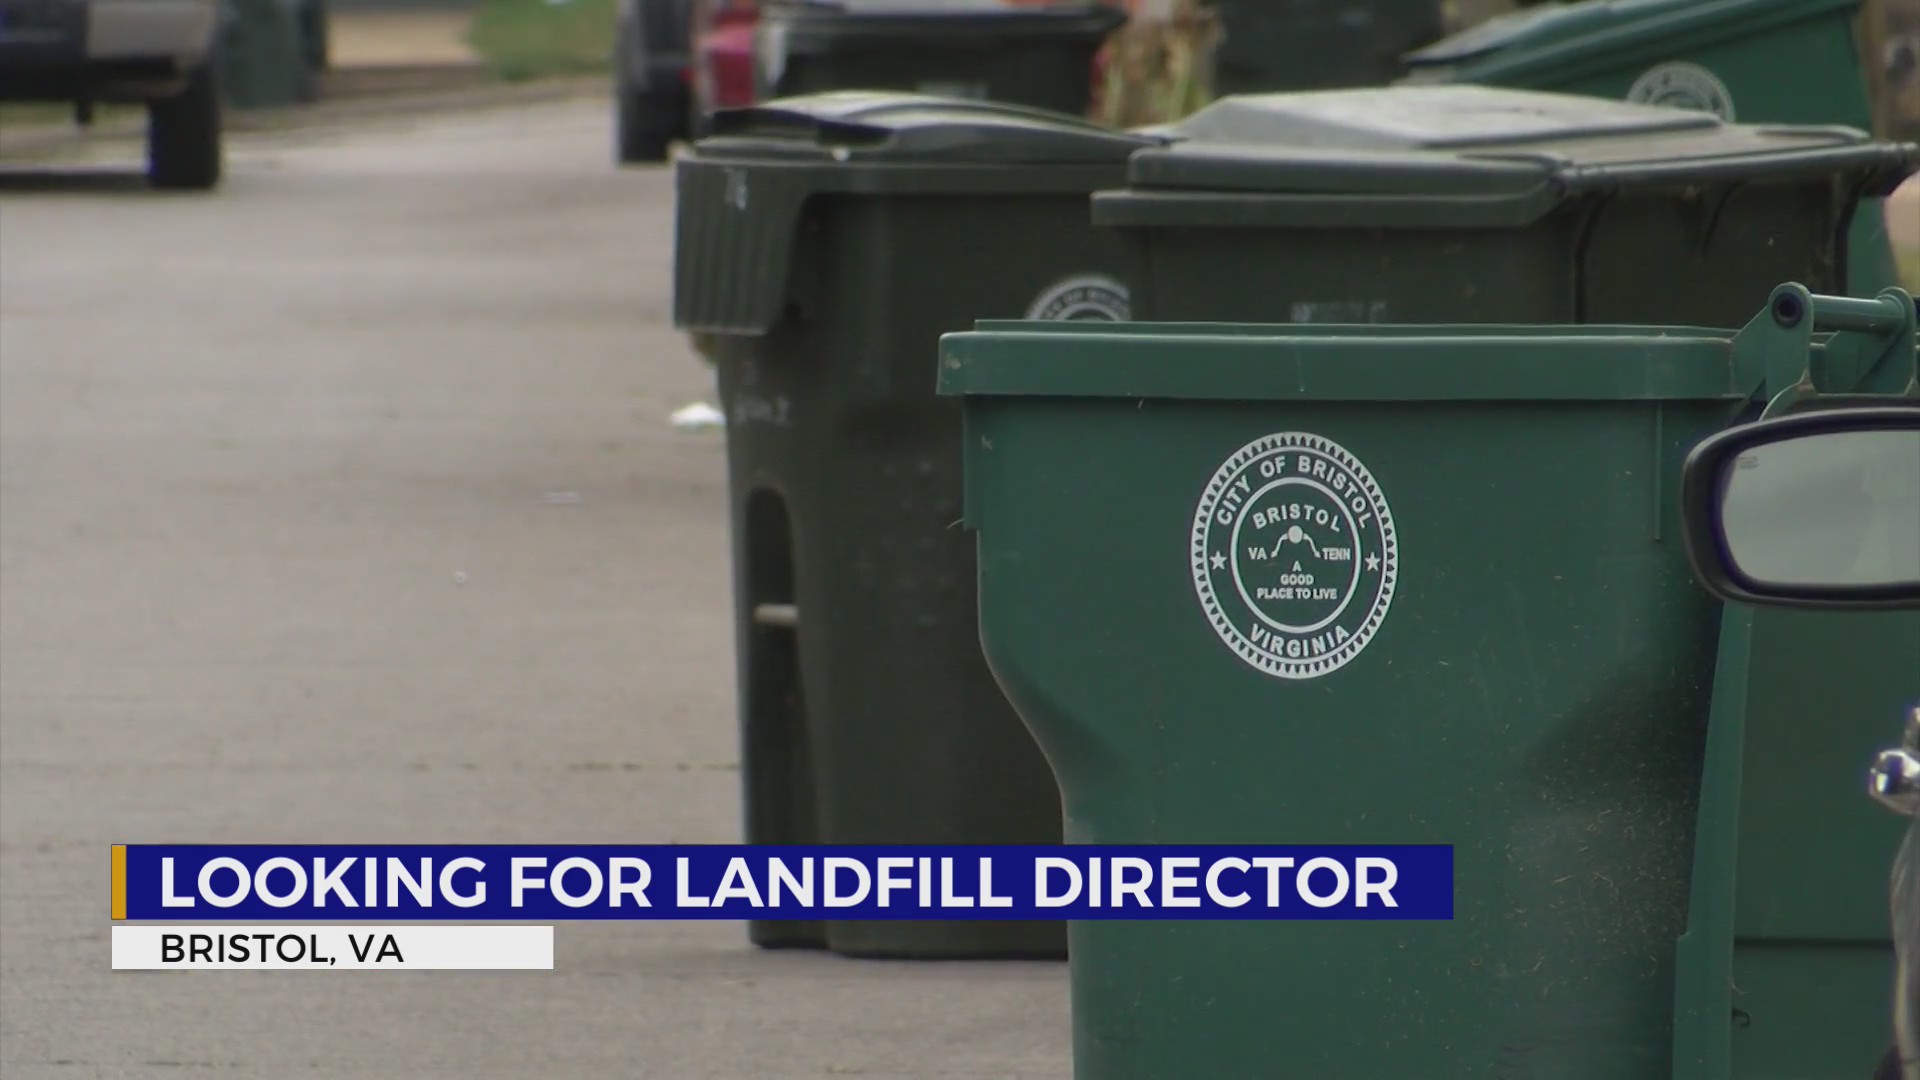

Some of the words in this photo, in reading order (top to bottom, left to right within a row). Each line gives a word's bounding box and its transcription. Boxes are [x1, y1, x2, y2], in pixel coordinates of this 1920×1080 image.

[1217, 475, 1251, 525] CITY
[1260, 456, 1286, 478] OF
[1298, 455, 1373, 528] BRISTOL
[1252, 503, 1341, 532] BRISTOL
[1248, 548, 1267, 560] VA
[1322, 548, 1350, 560] TENN
[1293, 561, 1302, 572] A
[1280, 574, 1314, 585] GOOD
[1257, 588, 1294, 599] PLACE
[1296, 588, 1309, 599] TO
[1313, 588, 1337, 600] LIVE
[1250, 623, 1350, 657] VIRGINIA
